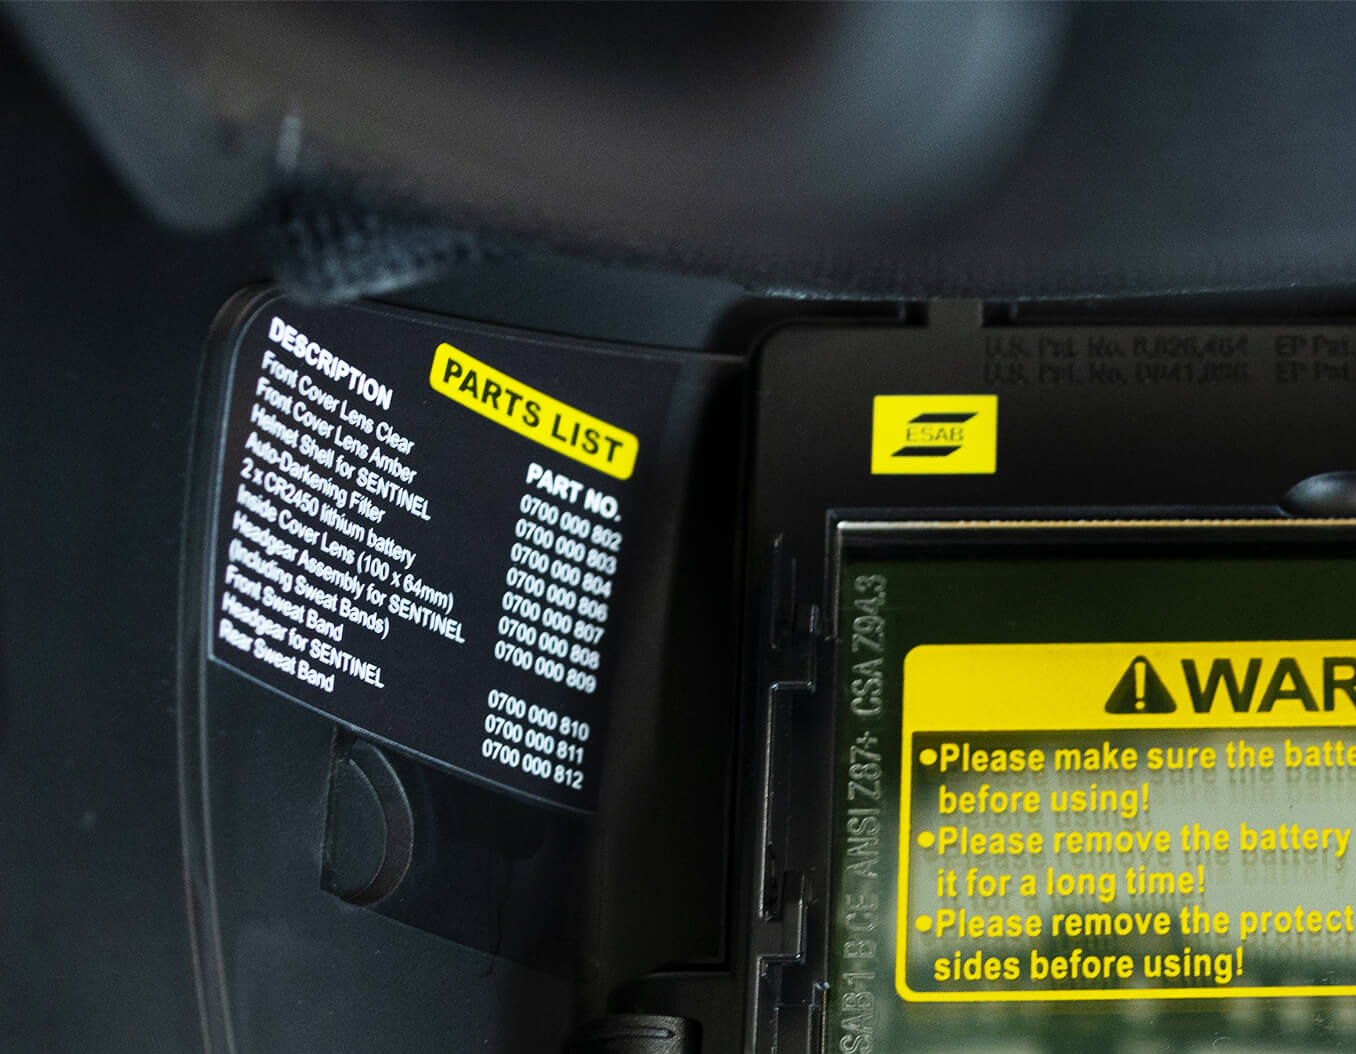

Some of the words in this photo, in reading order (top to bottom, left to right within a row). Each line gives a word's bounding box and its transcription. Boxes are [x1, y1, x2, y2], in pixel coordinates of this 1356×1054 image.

[269, 316, 393, 410] DESCRIPTION
[256, 376, 292, 415] Front
[293, 402, 335, 438] Cover
[334, 425, 369, 459] Lens
[368, 447, 417, 484] Amber
[261, 350, 298, 389] Front
[298, 376, 340, 413] Cover
[340, 400, 374, 434] Lens
[376, 422, 415, 455] Clear
[443, 357, 541, 427] PARTS
[551, 414, 623, 463] LIST
[250, 402, 299, 448] Helmet
[299, 434, 335, 469] Shell
[335, 455, 356, 480] for
[356, 467, 431, 521] SENTINEL
[906, 427, 963, 441] ESAB
[245, 432, 348, 508] Auto-Darkening
[349, 490, 386, 524] Filter
[525, 462, 584, 504] PART
[584, 488, 622, 522] NO.
[240, 457, 253, 480] 2
[252, 468, 264, 485] x
[264, 472, 319, 517] CR2450
[320, 502, 365, 542] lithium
[366, 528, 416, 569] battery
[520, 494, 559, 525] 0700
[560, 511, 591, 539] 000
[591, 525, 622, 552] 802
[237, 483, 278, 523] Inside
[278, 509, 320, 545] Cover
[320, 532, 355, 564] Lens
[357, 551, 390, 582] (100
[390, 571, 401, 588] x
[403, 574, 454, 615] 64mm)
[510, 543, 549, 574] 0700
[550, 560, 581, 586] 000
[582, 572, 612, 598] 804
[515, 518, 554, 549] 0700
[555, 535, 586, 562] 000
[586, 549, 617, 575] 803
[225, 564, 262, 600] Front
[262, 586, 305, 623] Sweat
[306, 608, 344, 641] Band
[232, 510, 299, 562] Headgear
[297, 550, 365, 600] Assembly
[366, 583, 387, 607] for
[388, 594, 466, 644] SENTINEL
[506, 567, 545, 598] 0700
[546, 584, 576, 610] 000
[294, 575, 338, 612] Sweat
[339, 597, 390, 640] Bands)
[502, 591, 541, 622] 0700
[542, 608, 573, 634] 000
[574, 620, 604, 645] 807
[851, 574, 887, 652] Z94.3
[219, 618, 253, 652] Rear
[253, 638, 296, 675] Sweat
[297, 659, 335, 692] Band
[222, 591, 288, 641] Headgear
[288, 627, 309, 652] for
[309, 638, 385, 689] SENTINEL
[494, 640, 533, 670] 0700
[535, 656, 565, 682] 000
[566, 668, 597, 693] 809
[498, 616, 537, 646] 0700
[538, 632, 568, 658] 000
[570, 644, 600, 670] 808
[488, 689, 527, 718] 0700
[528, 705, 558, 730] 000
[559, 716, 590, 742] 810
[850, 658, 884, 716] CSA
[482, 738, 520, 767] 0700
[522, 753, 552, 779] 000
[553, 764, 584, 790] 812
[485, 714, 523, 743] 0700
[525, 729, 555, 755] 000
[556, 740, 584, 764] 811
[848, 731, 882, 800] Z87+
[939, 742, 1045, 772] Please
[1054, 742, 1138, 770] make
[1147, 744, 1216, 768] sure
[1226, 740, 1274, 768] the
[939, 785, 1040, 813] before
[1050, 783, 1149, 818] using!
[847, 808, 880, 879] ANSI
[937, 826, 1043, 854] Please
[1053, 829, 1171, 853] remove
[1180, 824, 1230, 851] the
[1240, 822, 1350, 857] battery
[937, 869, 957, 897] it
[966, 867, 1010, 897] for
[1019, 874, 1037, 896] a
[1047, 867, 1116, 901] long
[1125, 865, 1205, 894] time!
[843, 940, 877, 960] B
[936, 908, 1042, 937] Please
[1052, 912, 1171, 936] remove
[1180, 906, 1230, 933] the
[934, 950, 1020, 981] sides
[1030, 949, 1134, 979] before
[1144, 946, 1245, 983] using!
